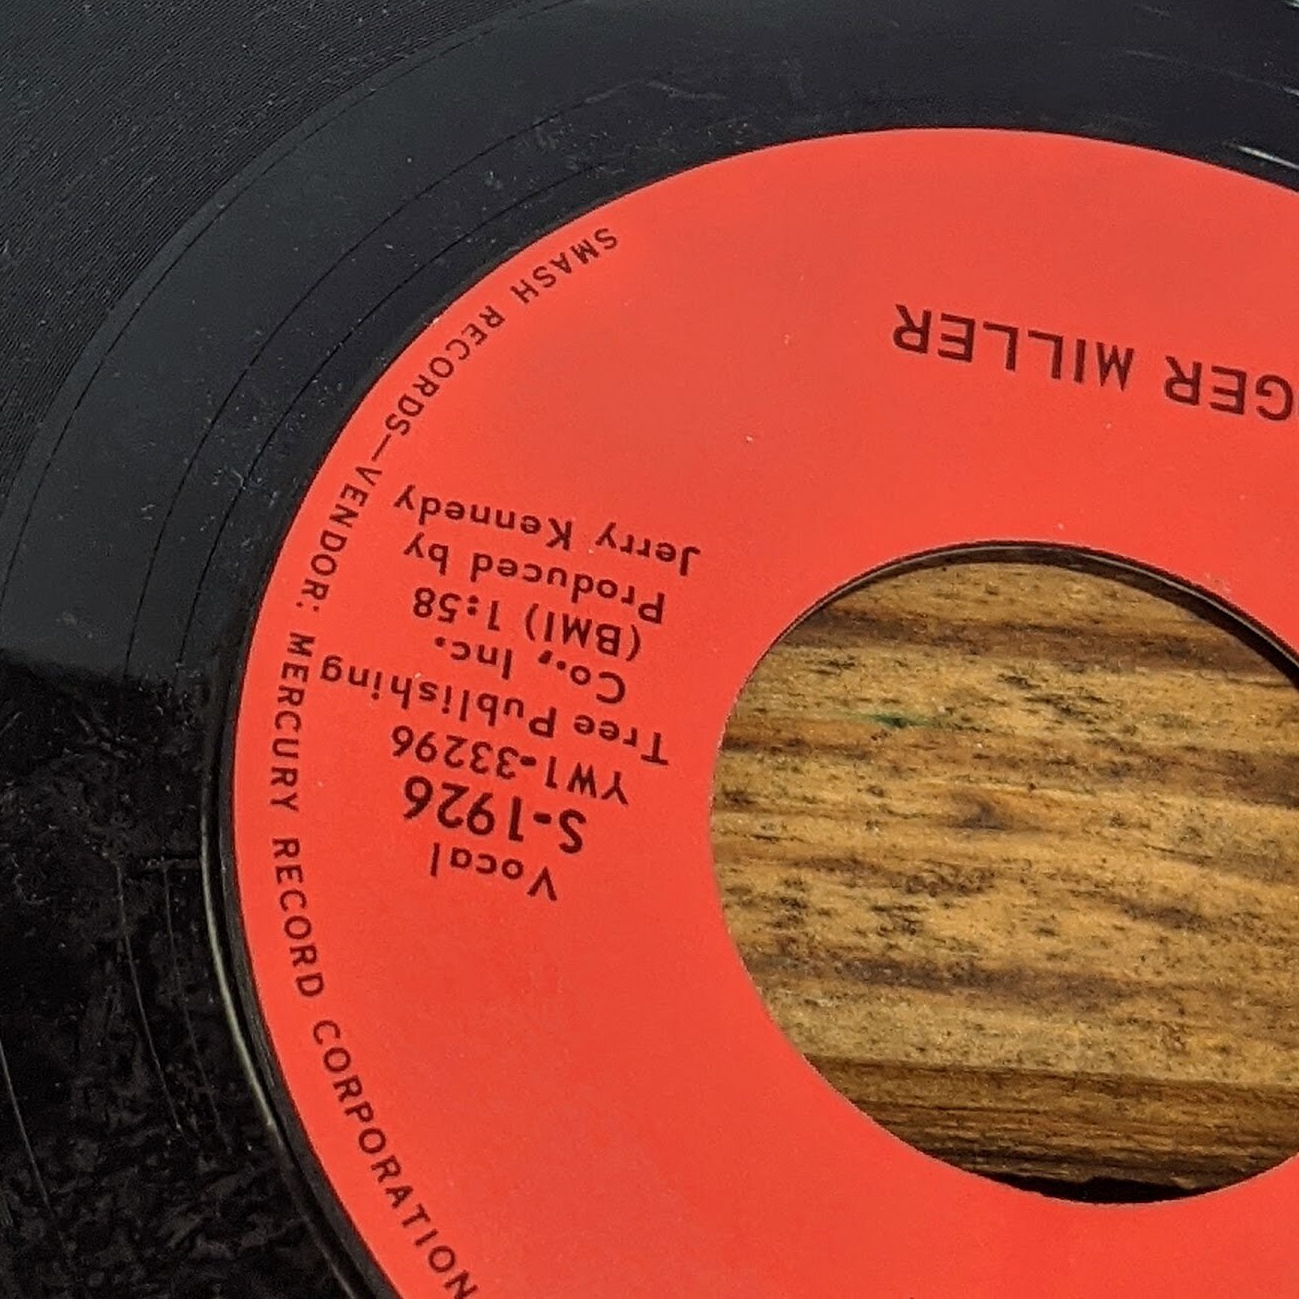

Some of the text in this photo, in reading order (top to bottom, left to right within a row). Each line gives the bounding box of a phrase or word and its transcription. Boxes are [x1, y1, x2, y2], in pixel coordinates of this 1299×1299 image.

[510, 228, 618, 304] SMASH
[892, 304, 1135, 392] MILLER
[393, 484, 701, 577] Jerry Kennedy
[403, 532, 666, 625] Produced by
[412, 587, 642, 662] (BMI) 1:58
[319, 654, 669, 766] Tree Publishing
[434, 636, 626, 705] Co., Inc.
[269, 632, 316, 812] MERCURY
[391, 725, 629, 806] YW1-33296
[403, 775, 587, 855] S-1926
[429, 842, 558, 902] Vocal
[272, 838, 325, 998] RECORD
[312, 1019, 478, 1299] CORPORATION
